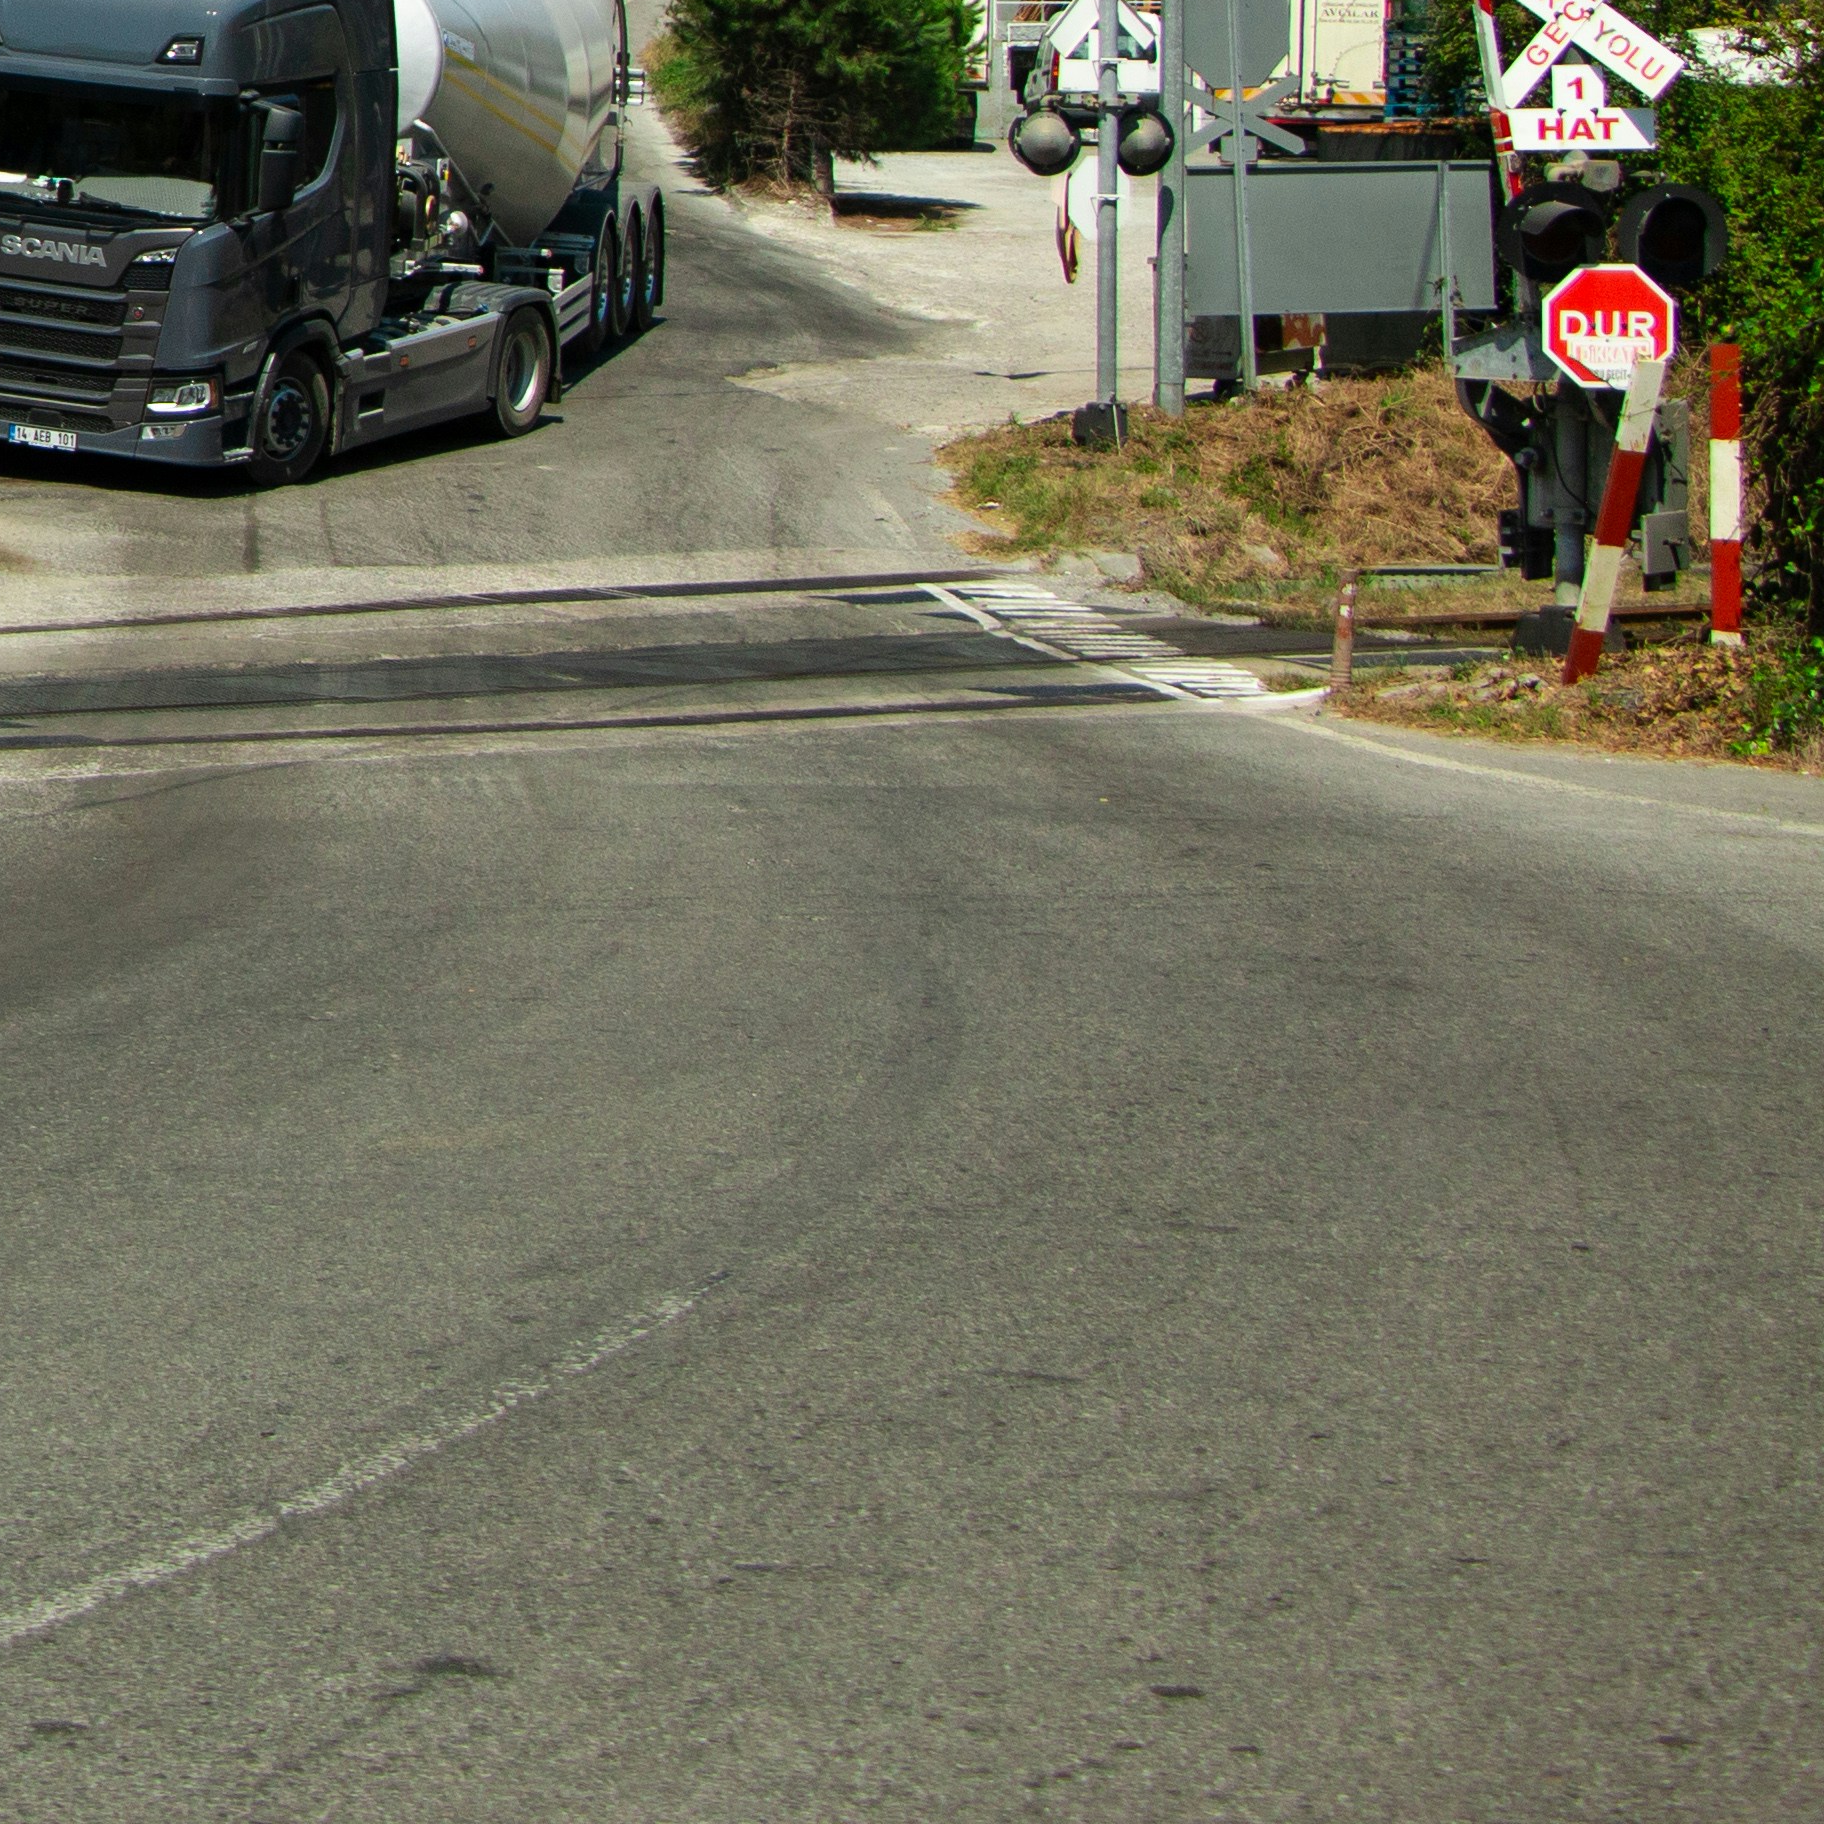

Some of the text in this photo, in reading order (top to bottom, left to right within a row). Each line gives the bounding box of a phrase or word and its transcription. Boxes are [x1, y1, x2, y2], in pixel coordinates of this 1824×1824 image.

[1592, 19, 1665, 81] YOLU
[1567, 76, 1584, 100] 1
[1537, 117, 1620, 141] HAT
[0, 234, 107, 268] SCANIA
[13, 296, 89, 316] SUPER
[1559, 309, 1655, 340] DUR
[16, 426, 27, 440] 14
[33, 429, 51, 443] AEB
[58, 432, 74, 446] 101
